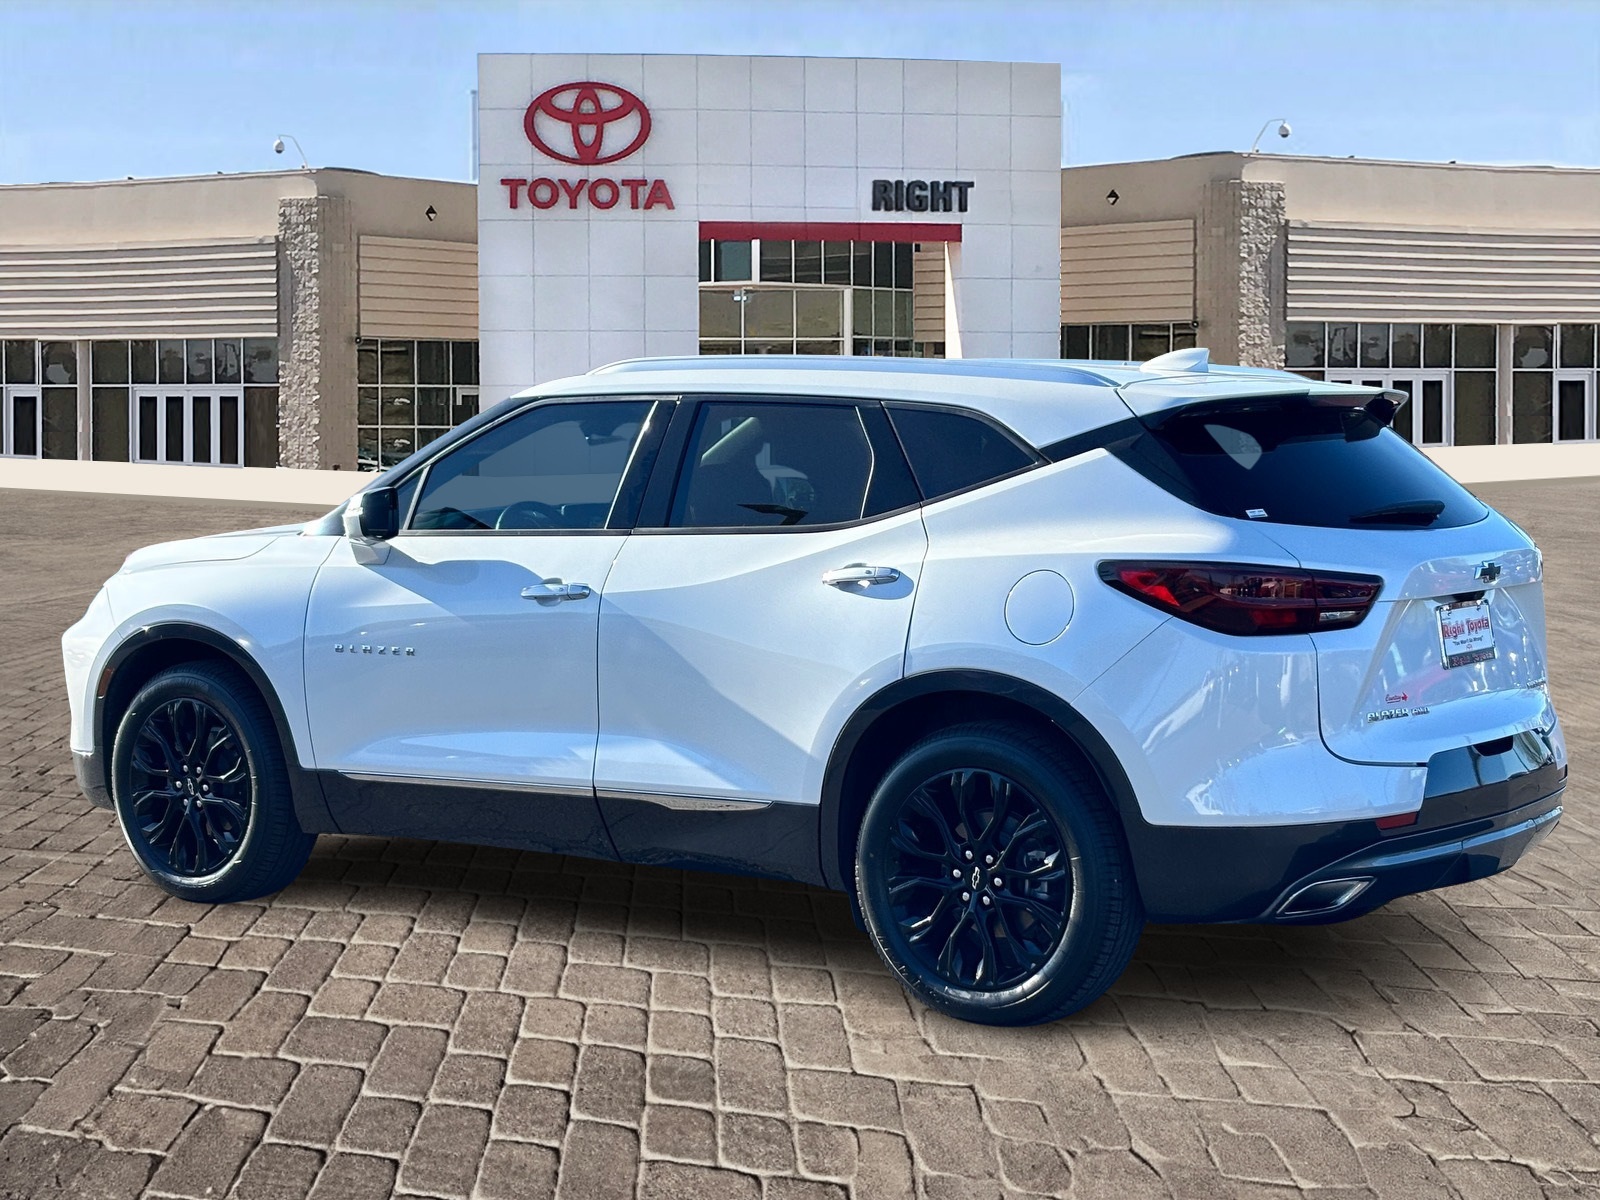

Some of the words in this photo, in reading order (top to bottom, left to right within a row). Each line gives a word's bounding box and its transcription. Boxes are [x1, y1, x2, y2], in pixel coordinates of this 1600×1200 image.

[500, 178, 675, 210] TOYOTA
[872, 179, 975, 212] RIGHT
[1442, 622, 1465, 639] Right
[1466, 617, 1489, 634] Toyota
[334, 643, 416, 656] BLAZER
[1367, 708, 1409, 723] BLAZER
